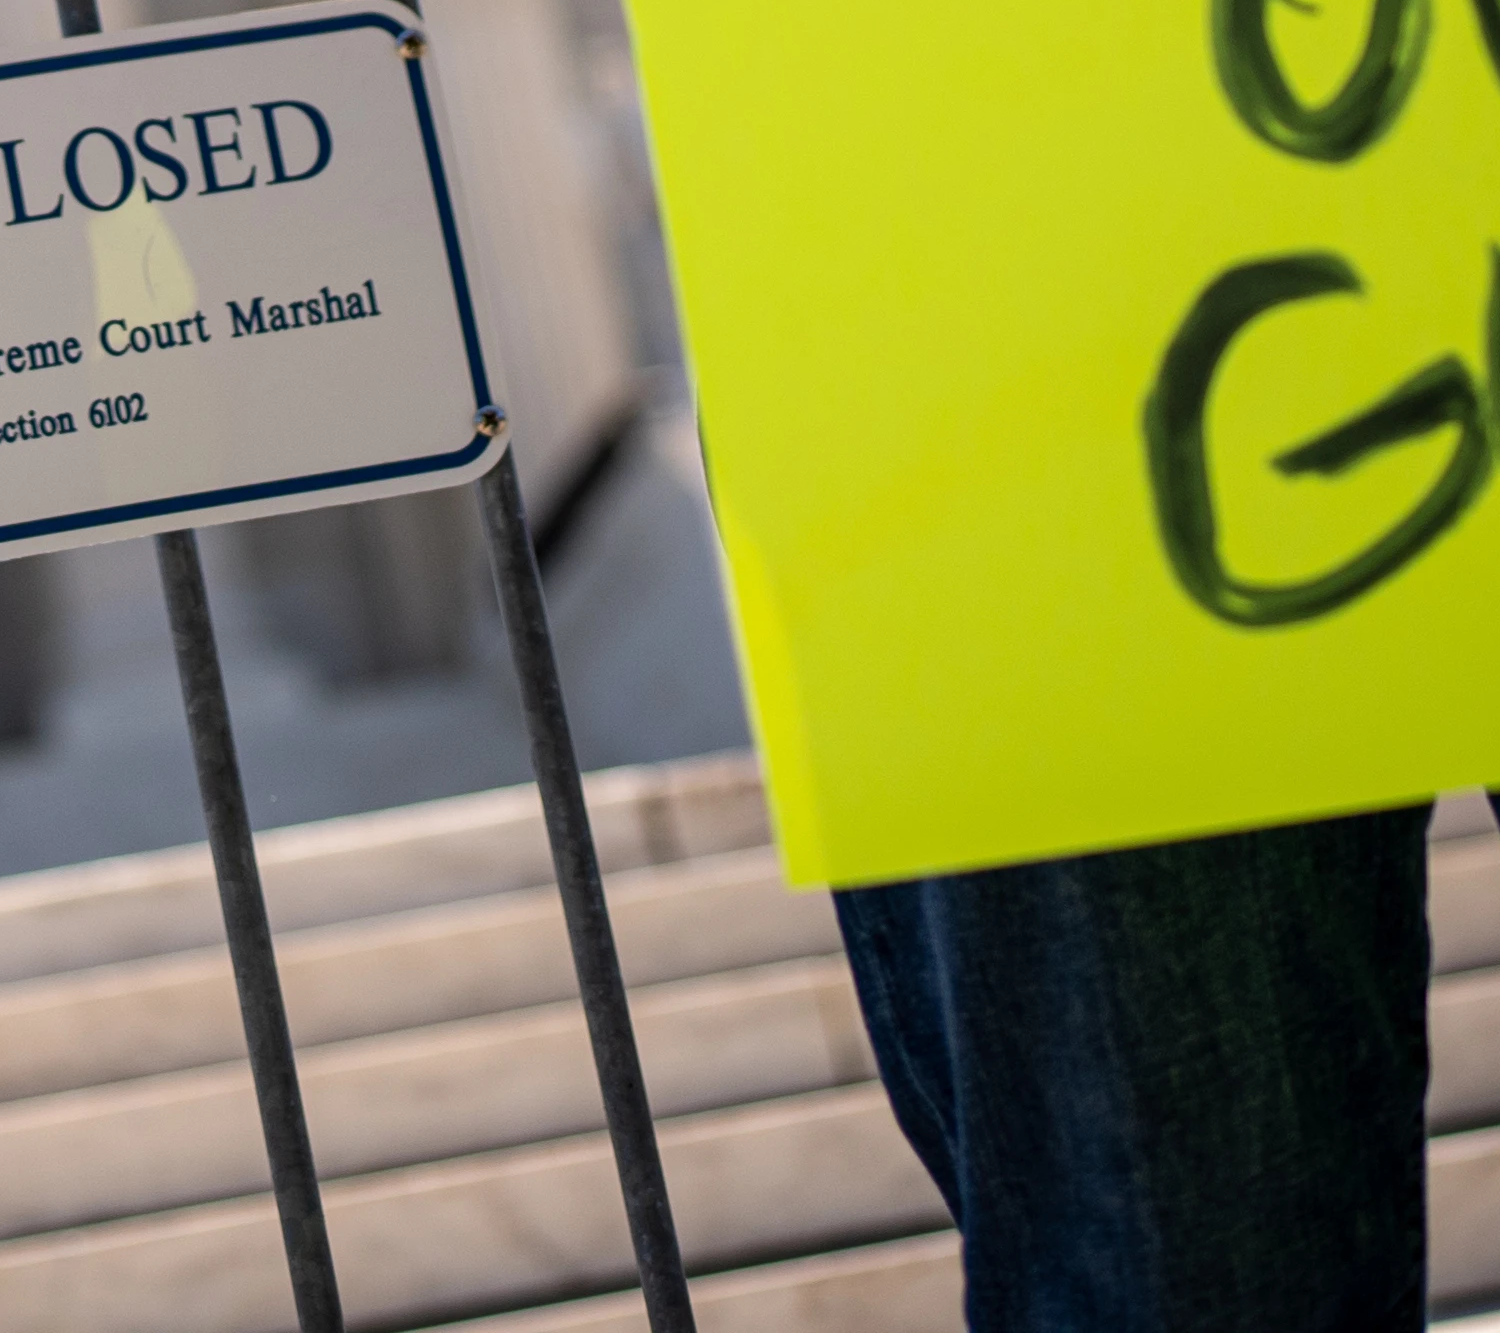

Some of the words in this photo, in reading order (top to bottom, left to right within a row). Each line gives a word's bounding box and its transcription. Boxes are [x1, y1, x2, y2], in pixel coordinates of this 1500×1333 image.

[98, 309, 213, 358] Court
[224, 278, 383, 340] Marshal
[87, 391, 150, 430] 6102
